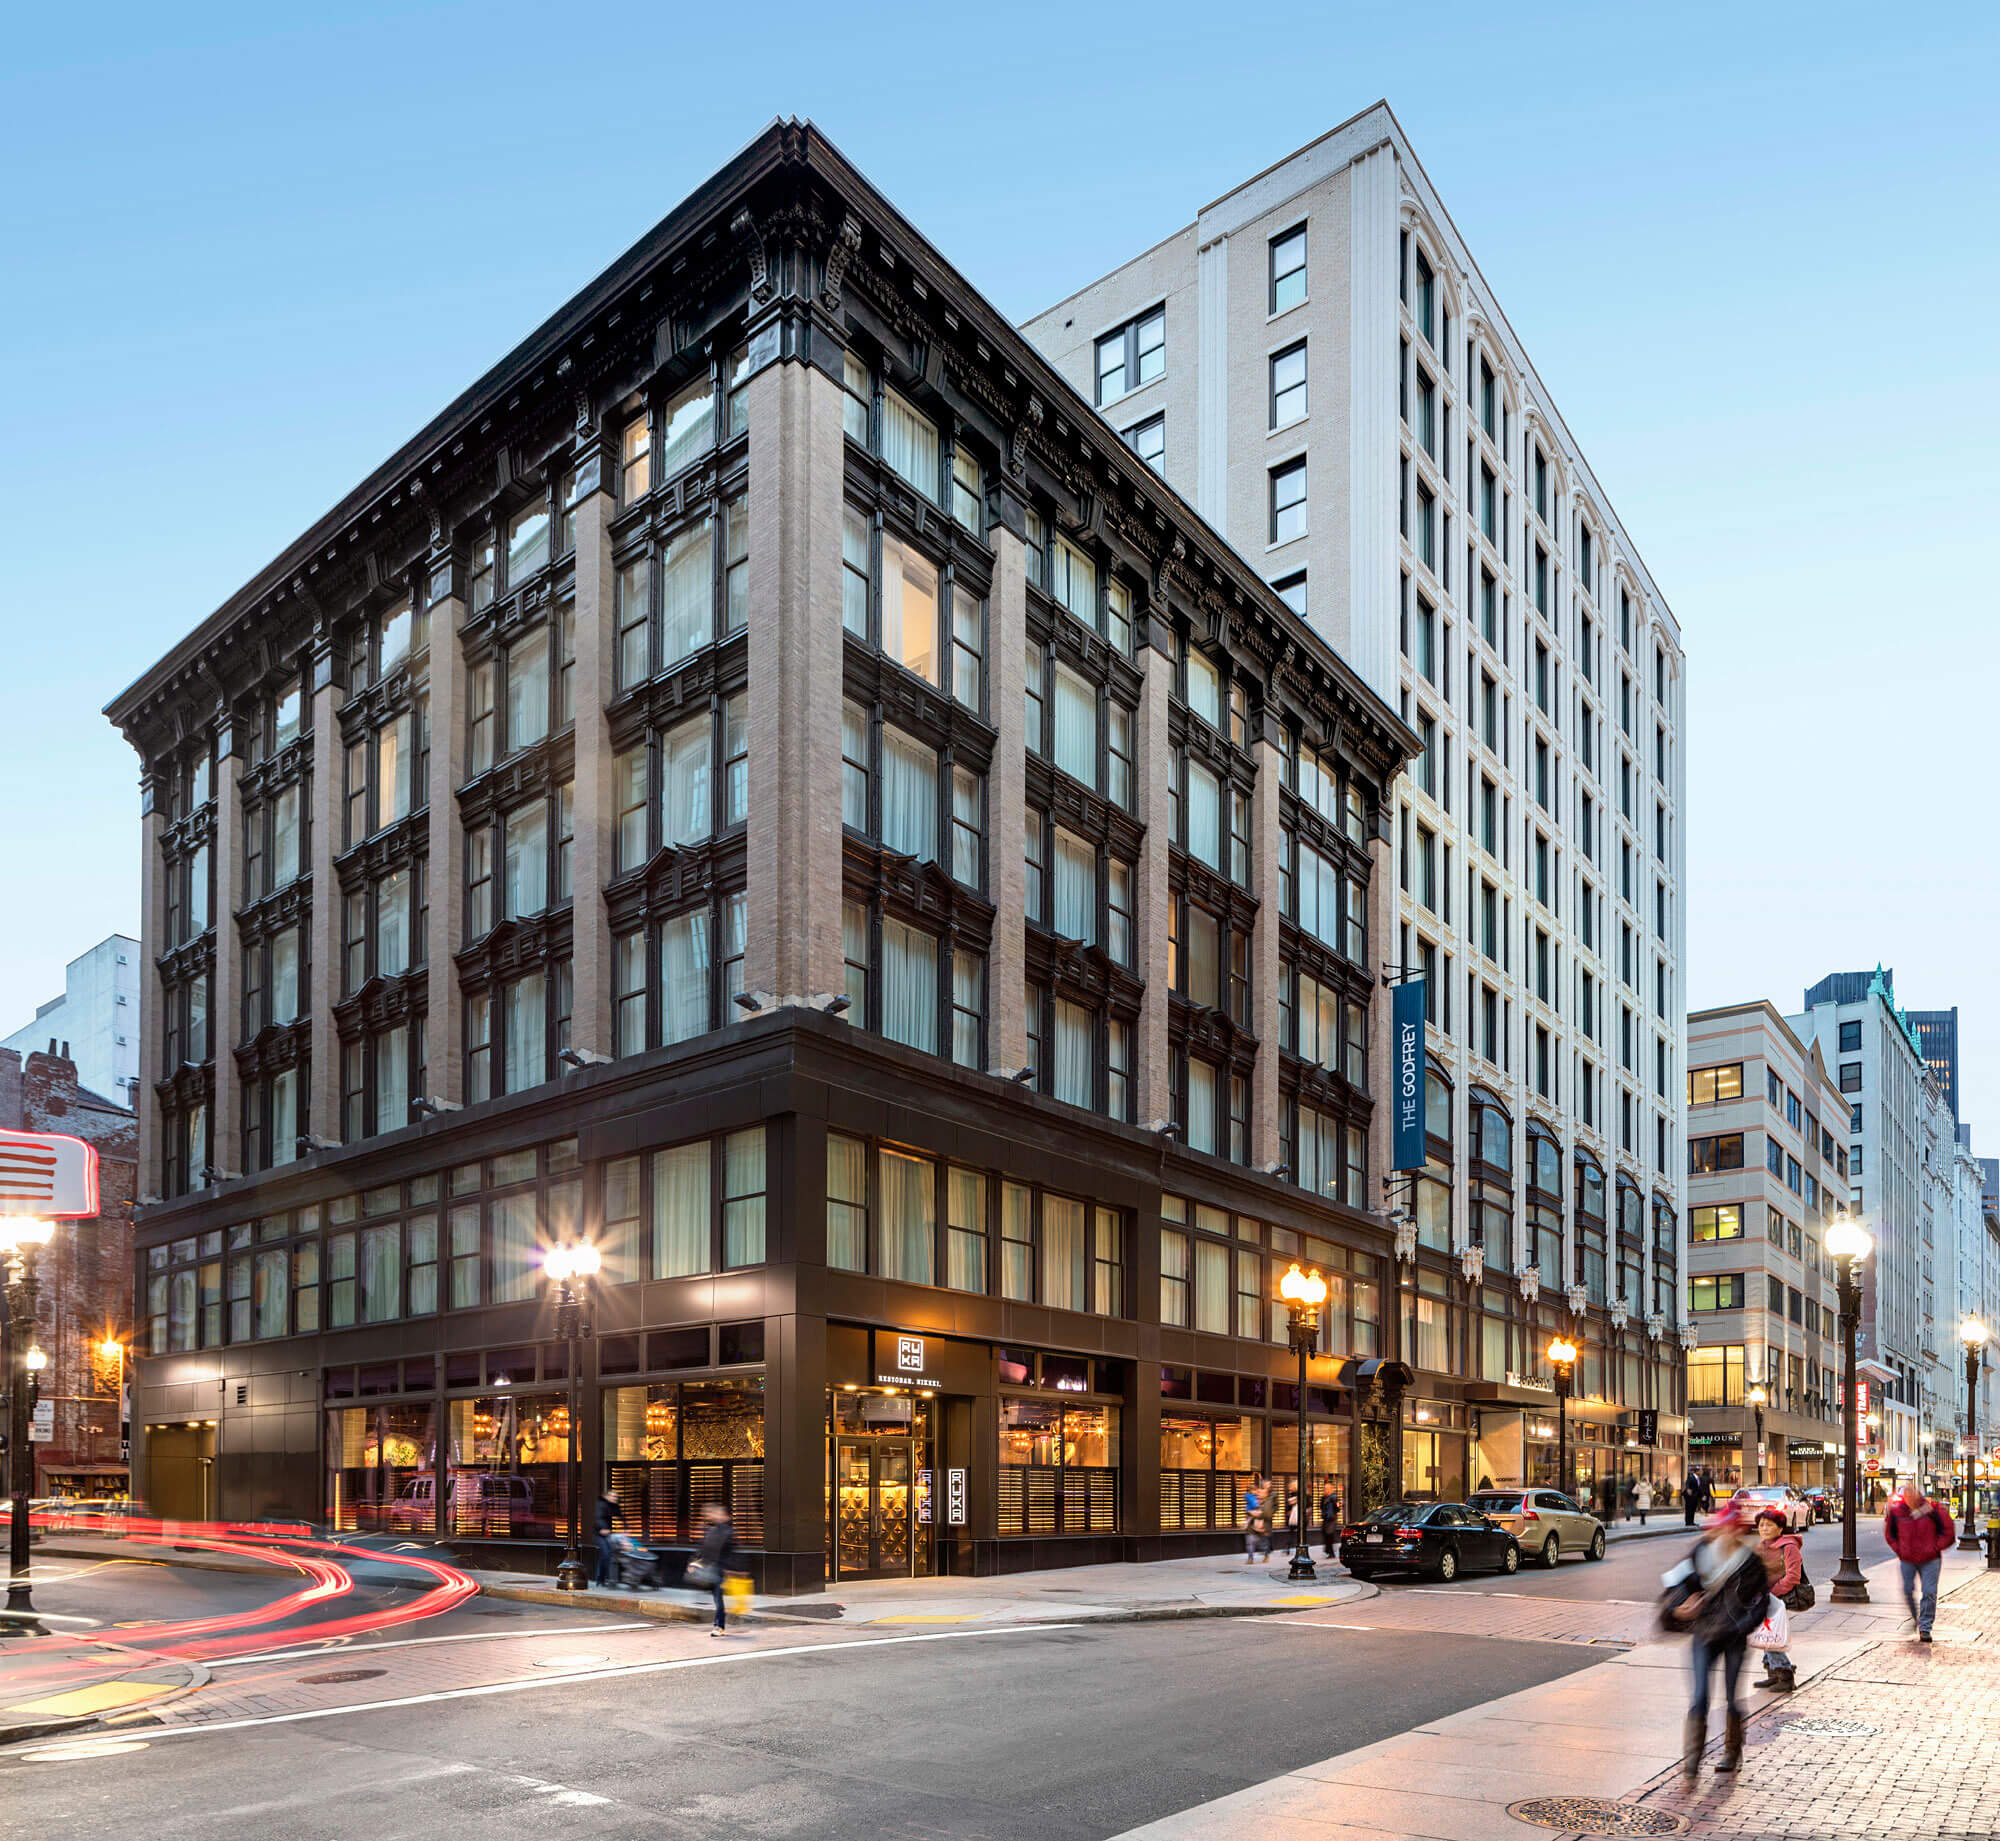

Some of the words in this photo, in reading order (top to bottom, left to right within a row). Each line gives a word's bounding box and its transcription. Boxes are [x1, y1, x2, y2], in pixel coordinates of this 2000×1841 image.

[1402, 1022, 1416, 1097] GODFREY
[1402, 1098, 1416, 1132] THE
[951, 1472, 962, 1521] RUKA
